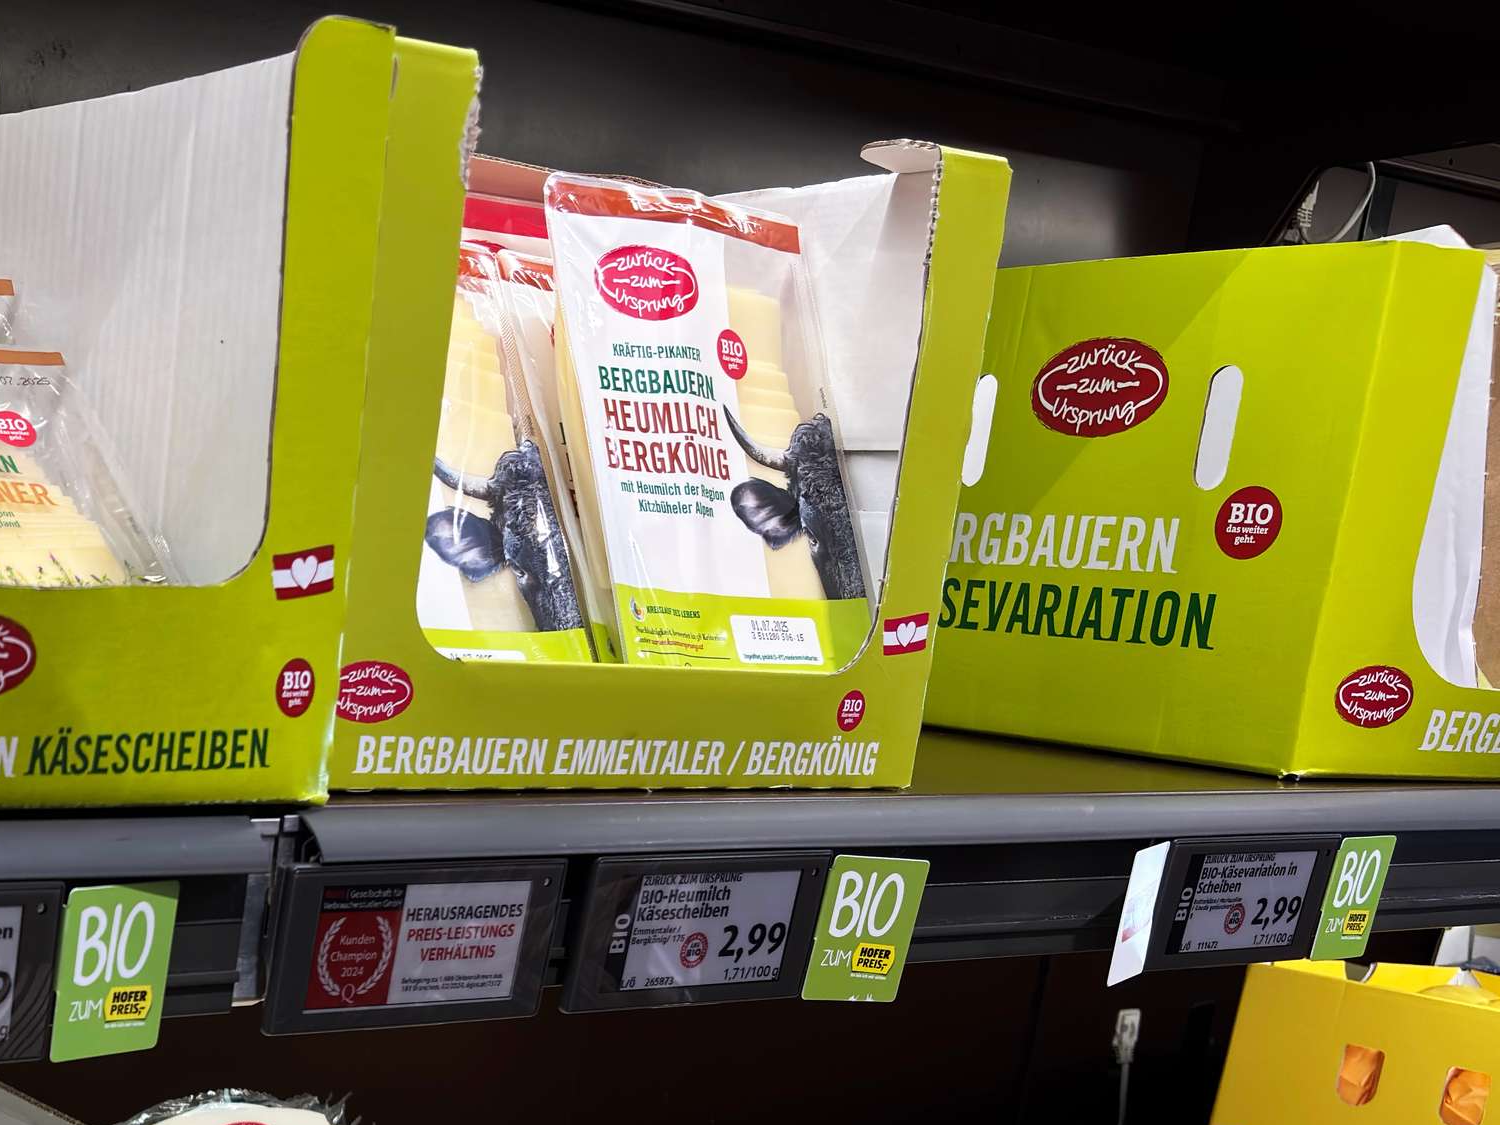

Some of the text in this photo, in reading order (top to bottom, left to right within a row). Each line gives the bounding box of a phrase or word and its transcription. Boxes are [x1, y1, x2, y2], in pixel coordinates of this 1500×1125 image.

[612, 341, 702, 363] KRÄFTIG-PIKANTER
[721, 340, 742, 358] BIO
[1068, 345, 1141, 374] zurück
[599, 365, 716, 401] BERGBAUERN
[1077, 377, 1118, 394] zum
[604, 398, 722, 442] HEUMILCH
[1052, 399, 1135, 432] Ursprung
[606, 434, 731, 482] BERGKÖNIG
[620, 480, 725, 502] mit Heumilch der Region
[638, 498, 715, 518] Kitzbüheler Alpen
[1228, 502, 1273, 524] BIO
[1241, 525, 1269, 535] weiter
[948, 512, 1180, 574] RGBAUERN
[938, 579, 1216, 650] SEVARIATION
[282, 670, 311, 689] BIO
[842, 698, 863, 713] BIO
[25, 723, 270, 776] KÄSESCHEIBEN
[354, 736, 879, 776] BERGBAUERN EMMENTALER BERGKÖNIG
[700, 873, 743, 884] URSPRUNG
[1201, 862, 1287, 879] BIO-Käsevariation
[1333, 849, 1381, 908] BIO
[641, 886, 731, 905] BIO-Heumilch
[1197, 880, 1242, 894] Scheiben
[406, 904, 523, 922] HERAUSRAGENDES
[637, 904, 729, 921] Käsescheiben
[830, 870, 905, 939] BIO
[1175, 887, 1193, 921] BIO
[1251, 896, 1301, 930] 2,99
[407, 923, 516, 941] PREIS-LEISTUNGS
[609, 914, 631, 954] BIO
[1325, 913, 1366, 933] ZUM HOFER
[73, 901, 155, 985] BIO
[340, 934, 376, 944] Kunden
[718, 922, 786, 963] 2,99
[331, 951, 377, 962] Champion
[420, 944, 495, 962] VERHÄLTNIS
[821, 946, 891, 970] ZUM HOFER
[341, 967, 364, 977] 2024
[724, 966, 771, 980] 1,71/100
[69, 989, 149, 1020] ZUM HOFER
